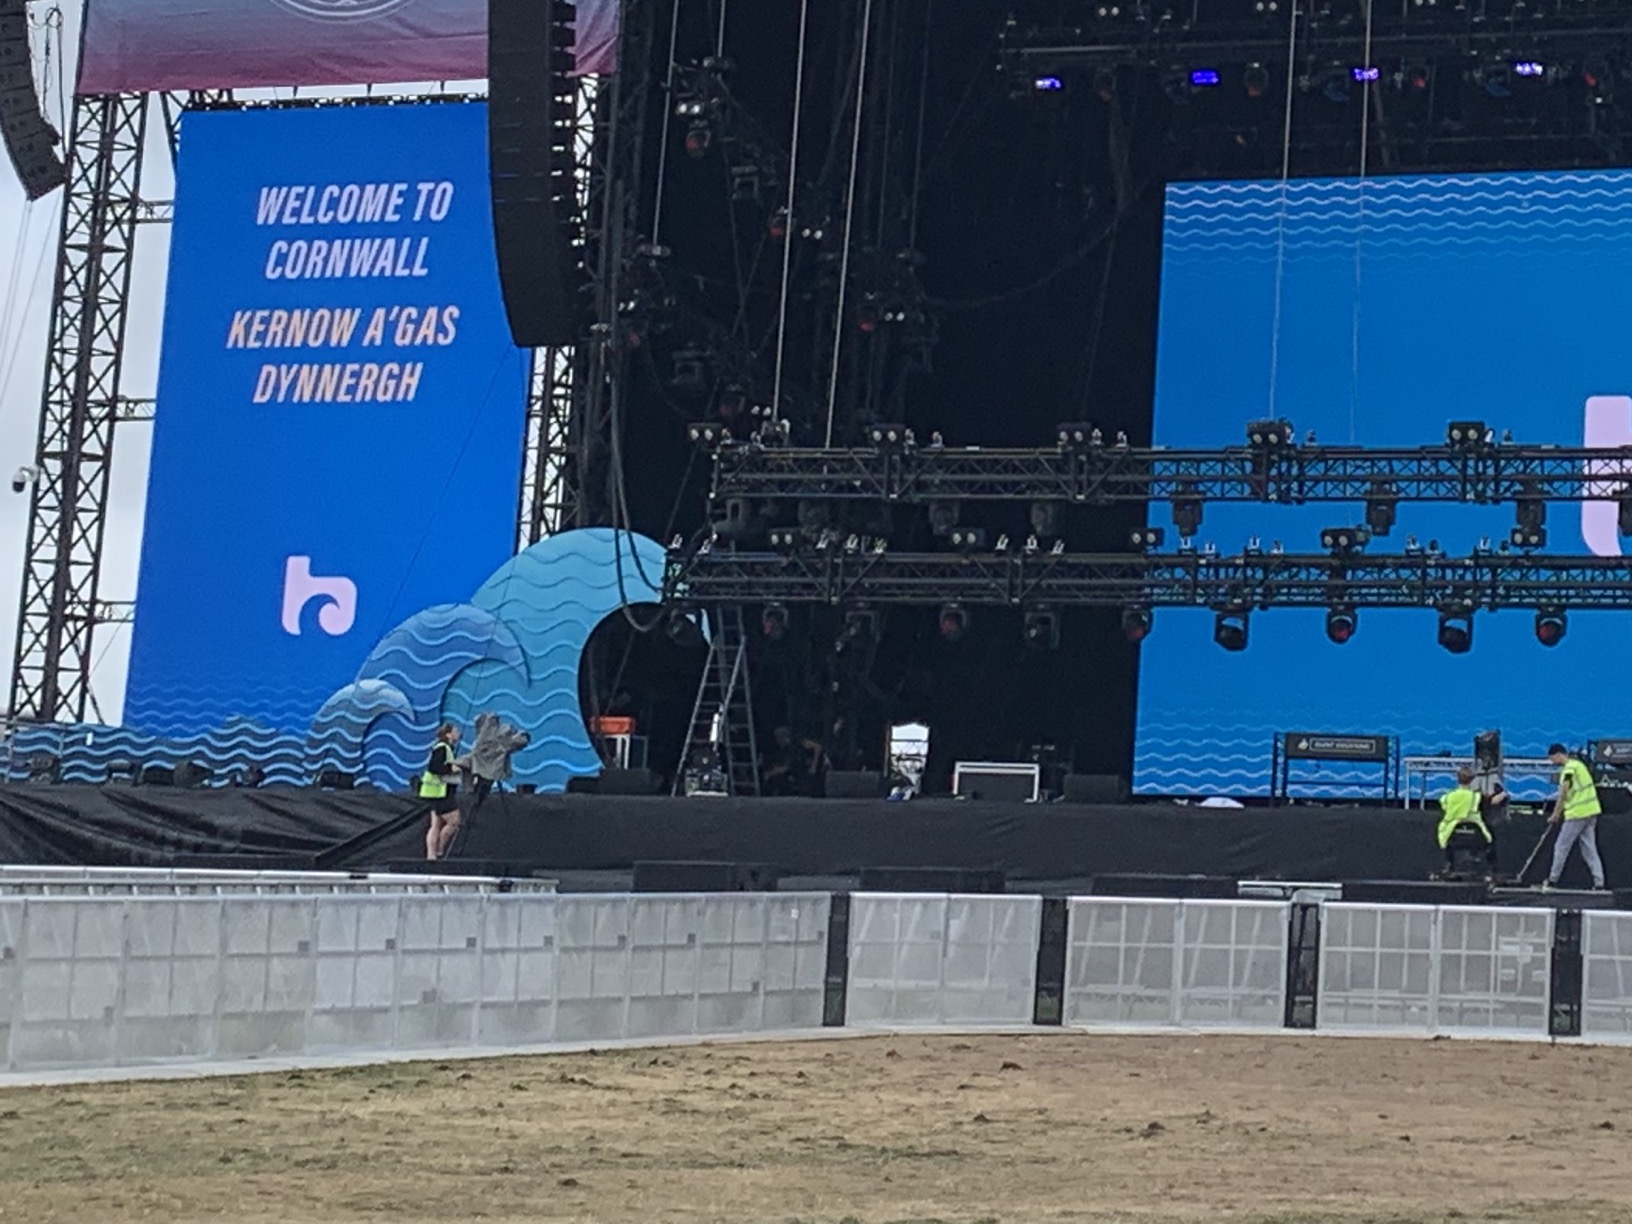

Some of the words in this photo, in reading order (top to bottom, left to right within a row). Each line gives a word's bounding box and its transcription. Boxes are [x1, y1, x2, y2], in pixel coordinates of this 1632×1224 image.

[256, 182, 407, 226] WELCOME
[412, 181, 454, 223] TO
[265, 236, 430, 280] CORNWALL
[226, 307, 362, 350] KERNOW
[363, 305, 460, 347] A'GAS
[252, 361, 424, 404] DYNNERGH
